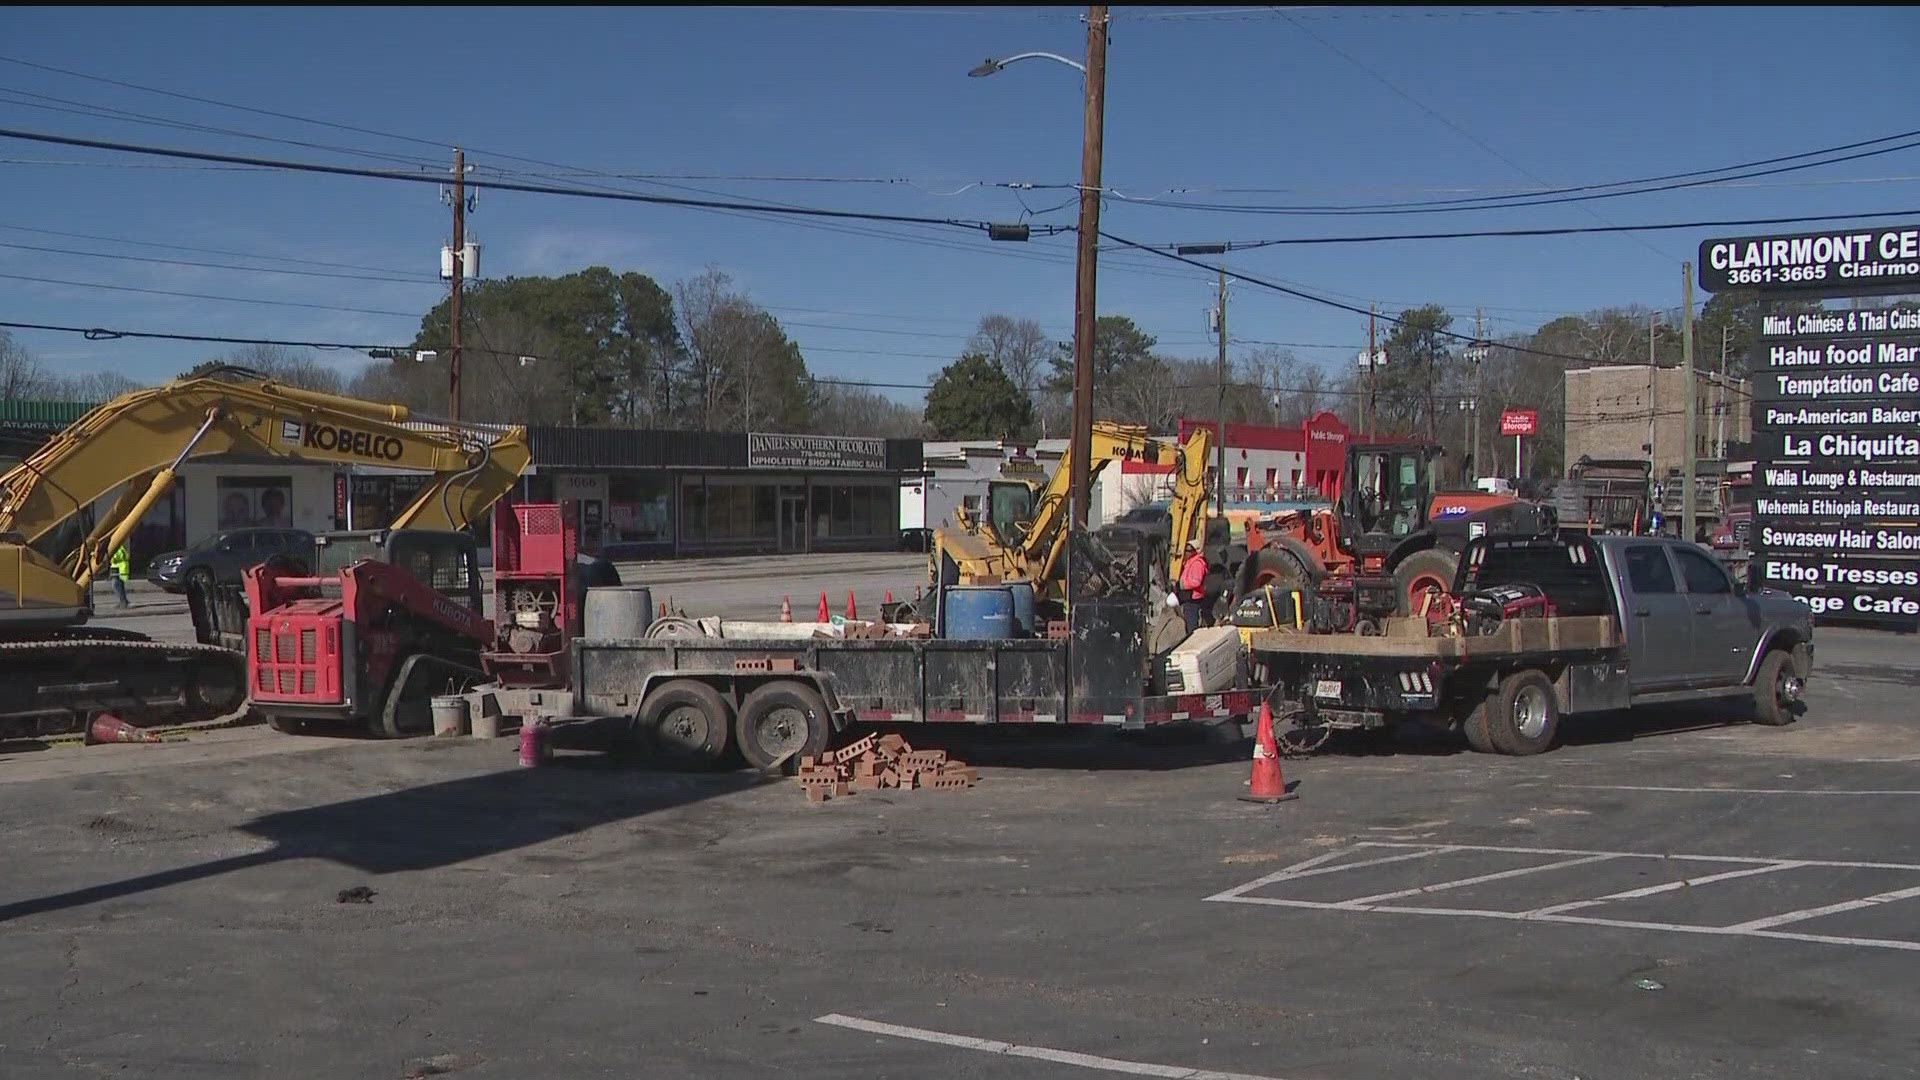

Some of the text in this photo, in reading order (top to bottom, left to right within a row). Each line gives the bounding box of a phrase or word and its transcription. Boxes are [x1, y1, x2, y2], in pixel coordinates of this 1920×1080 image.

[1710, 231, 1920, 270] CLAIRMONT CE
[1728, 266, 1826, 283] 3661-3665
[1848, 313, 1856, 331] &
[1860, 311, 1887, 330] Thai
[1771, 346, 1820, 365] Hahu
[1827, 344, 1871, 363] food
[1778, 373, 1919, 398] Temptation Cafe
[2, 421, 48, 429] ATLANTA
[1768, 409, 1867, 424] Pan-American
[1503, 423, 1531, 431] Storage
[304, 422, 403, 461] KOBELCO
[790, 438, 835, 450] SOUTHERN
[1311, 430, 1344, 443] Public Storage
[1785, 435, 1919, 460] La Chiquita
[752, 457, 883, 469] UPHOLSTERY SHOP FABRIC SALE
[1766, 470, 1797, 485] Walia
[1803, 470, 1844, 489] Lounge
[1848, 470, 1856, 485] &
[1446, 506, 1466, 514] 140
[1758, 500, 1808, 514] Wehemia
[1813, 500, 1861, 518] Ethiopia
[1763, 528, 1836, 547] Sewasew
[1840, 530, 1873, 548] Hair
[1767, 562, 1918, 584] Etho Tresses
[1854, 596, 1919, 613] Cafe
[432, 600, 471, 628] KUBOTA
